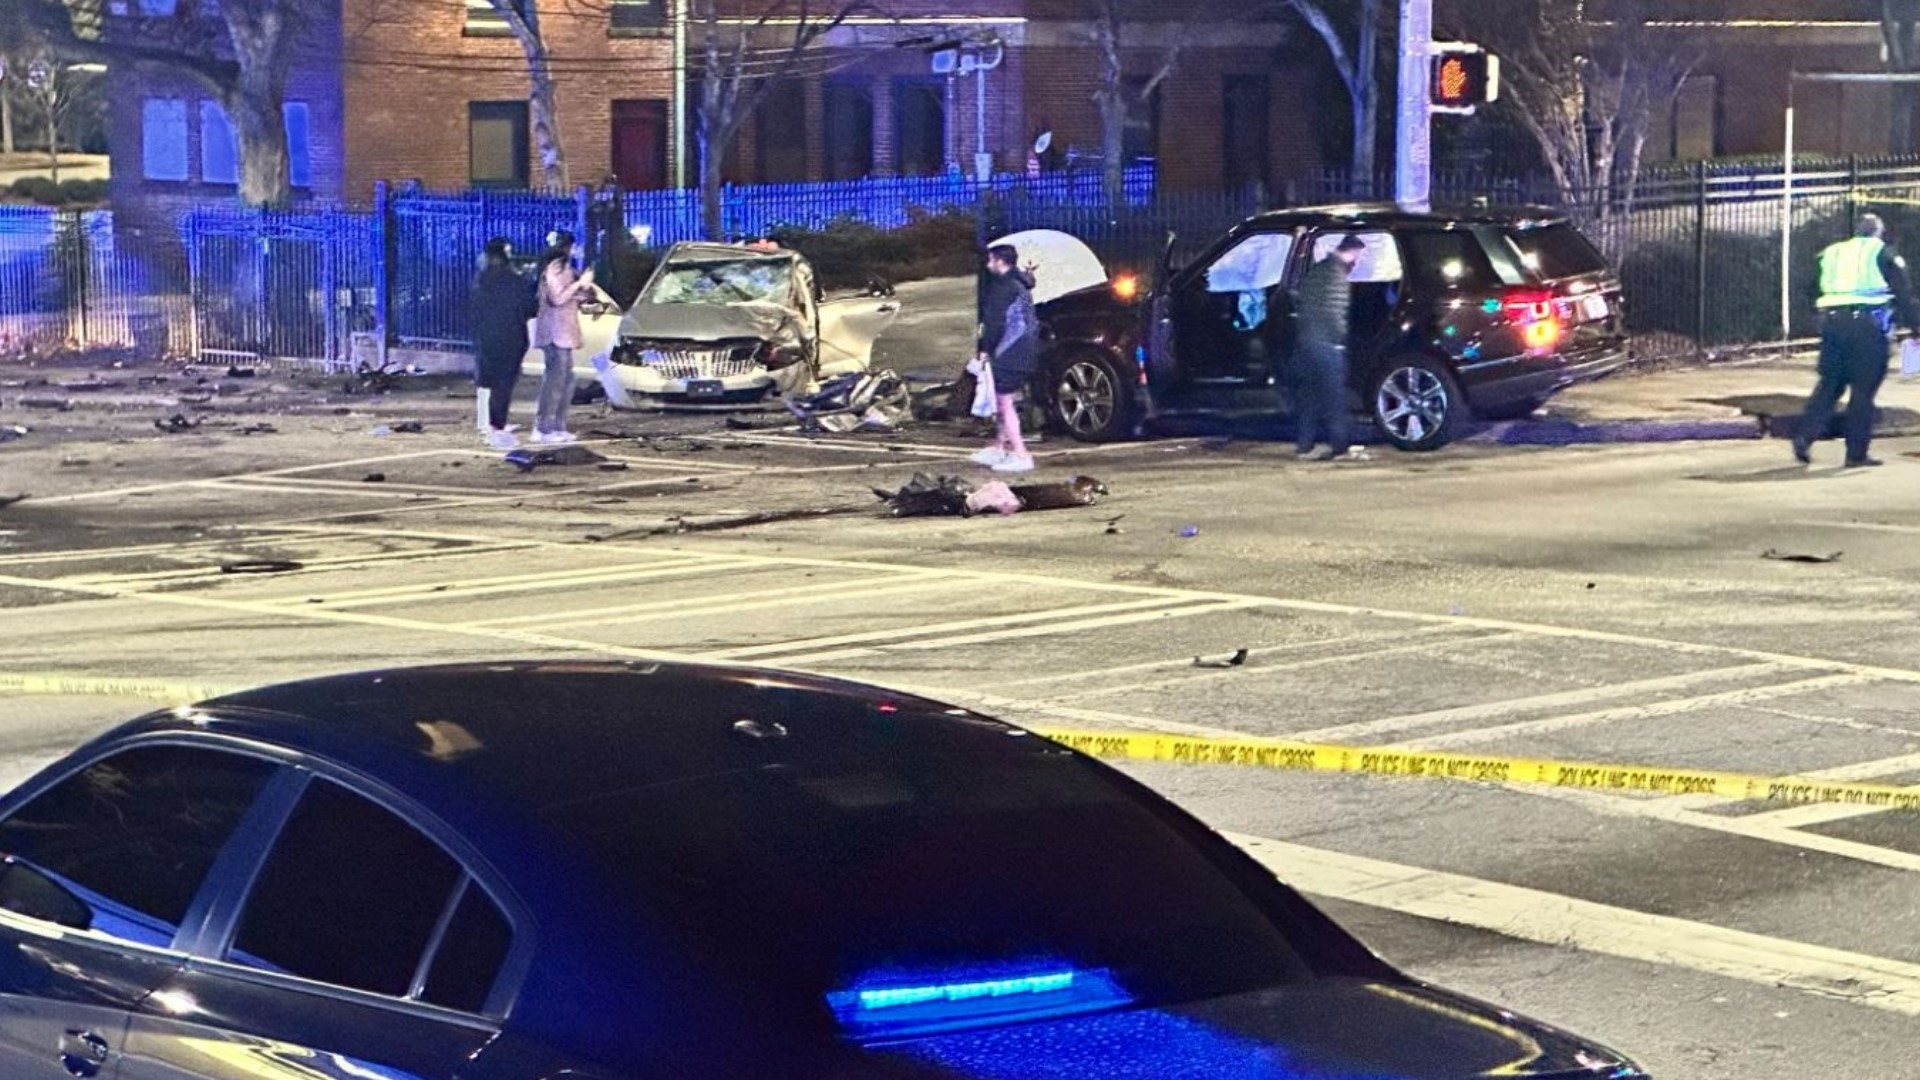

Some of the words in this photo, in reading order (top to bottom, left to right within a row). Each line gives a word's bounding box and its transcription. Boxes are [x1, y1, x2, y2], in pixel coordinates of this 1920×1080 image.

[1173, 742, 1210, 762] POLICE
[1212, 745, 1237, 763] LINE
[1239, 746, 1254, 765] DO
[1256, 747, 1278, 767] NOT
[1279, 748, 1316, 769] CROSS
[1361, 753, 1399, 772] POLICE
[1401, 756, 1426, 774] LINE
[1429, 758, 1445, 776] DO
[1447, 759, 1470, 778] NOT
[1471, 760, 1510, 780] CROSS
[1557, 766, 1600, 786] POLICE
[1601, 769, 1628, 788] LINE
[1630, 772, 1647, 789] DO
[1649, 773, 1674, 791] NOT
[1675, 775, 1717, 794] CROSS
[1768, 783, 1812, 804] POLICE
[1814, 787, 1842, 804] LINE
[1845, 789, 1863, 805] DO
[1866, 792, 1891, 807] NOT
